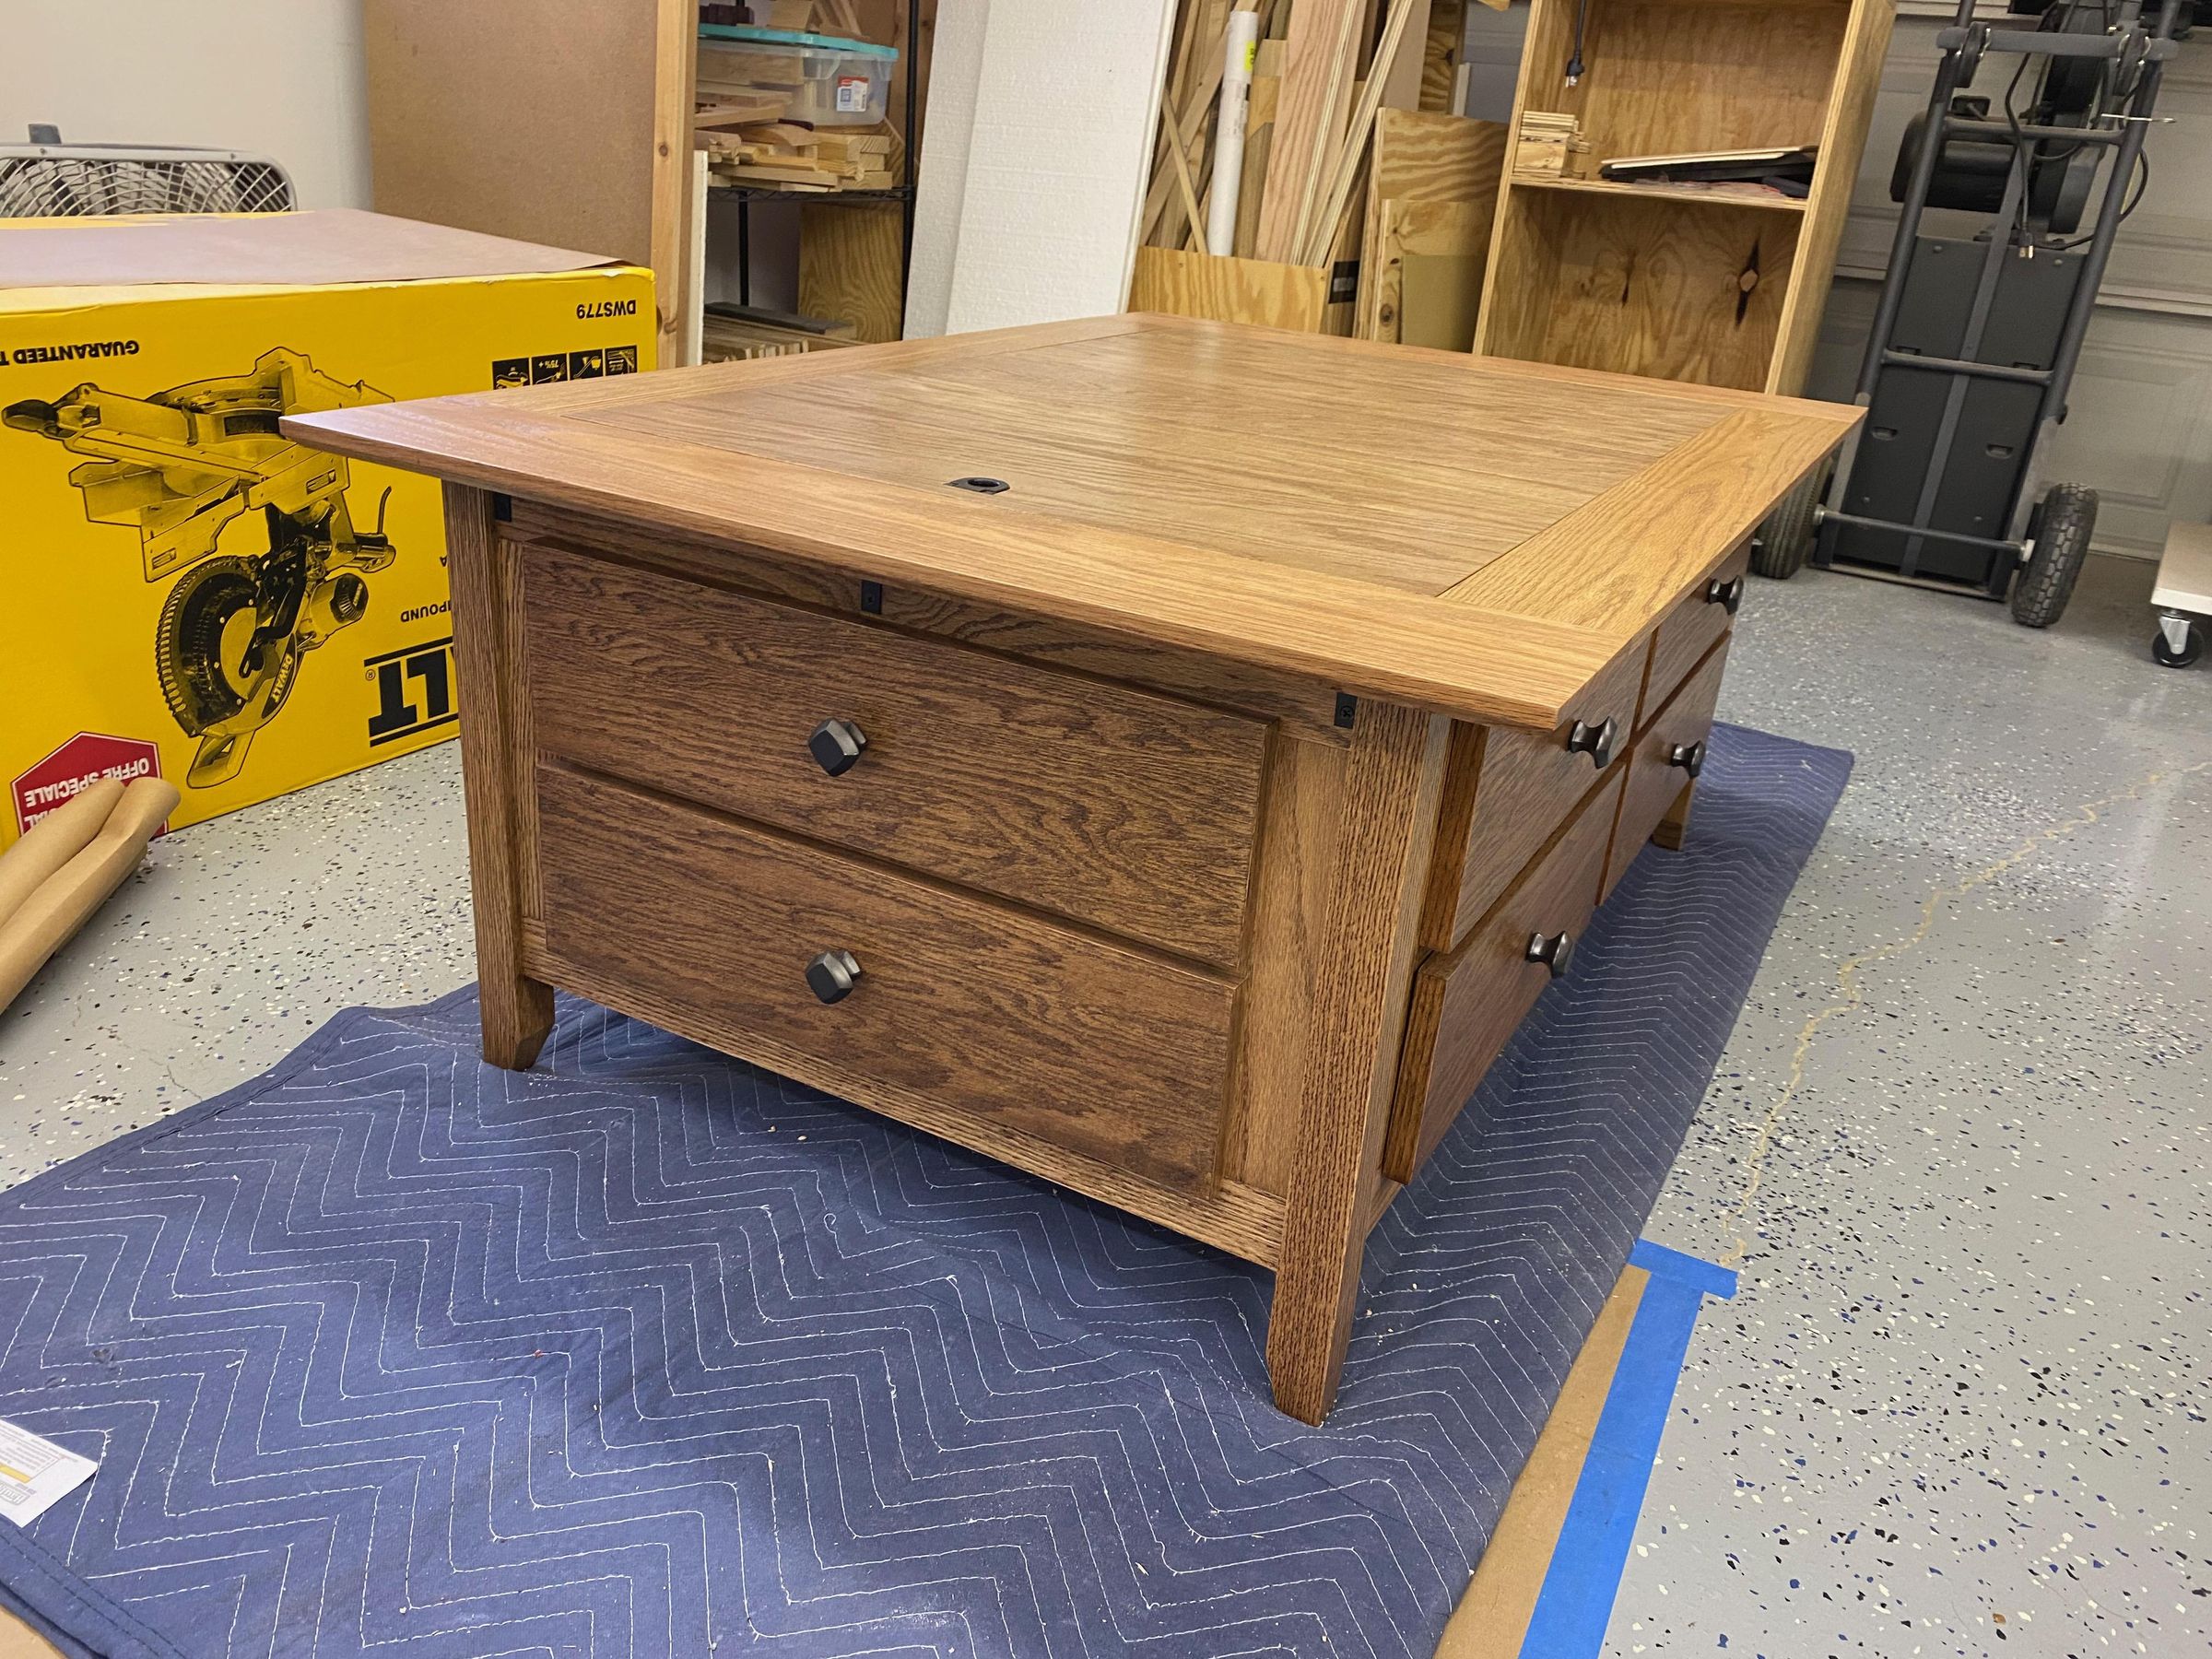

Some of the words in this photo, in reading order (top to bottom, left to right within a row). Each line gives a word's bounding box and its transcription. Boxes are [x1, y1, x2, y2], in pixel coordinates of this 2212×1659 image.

[577, 300, 636, 319] DWS779
[13, 340, 139, 364] GUARANTEED
[400, 599, 452, 623] POUND
[369, 647, 455, 737] LT
[102, 758, 149, 782] OFFRE
